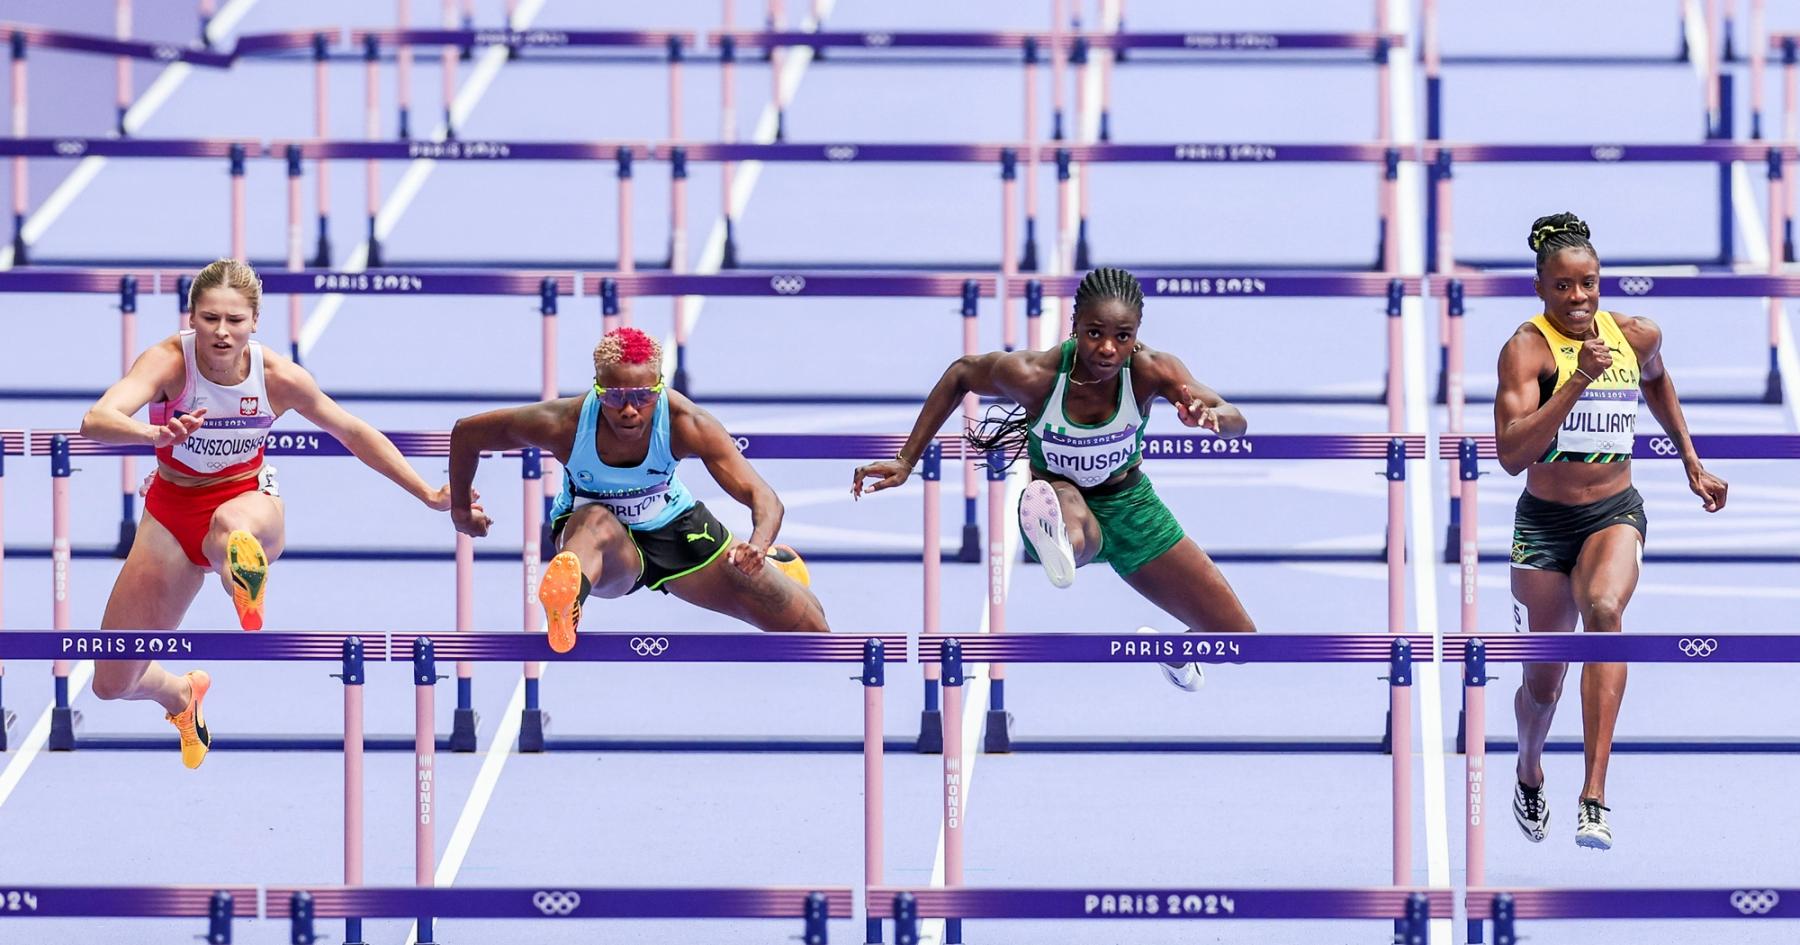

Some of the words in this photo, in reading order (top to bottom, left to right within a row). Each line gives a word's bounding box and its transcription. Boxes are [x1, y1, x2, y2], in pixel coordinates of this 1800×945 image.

[372, 275, 422, 290] 2024
[1215, 278, 1266, 293] 2024
[267, 435, 319, 449] 2024
[1200, 439, 1252, 454] 2024
[1045, 443, 1134, 471] AMUSAN
[134, 638, 192, 653] 2024
[1182, 640, 1240, 656] 2024
[418, 770, 432, 825] MONDO
[946, 773, 960, 828] MONDO
[1469, 771, 1482, 826] MONDO
[1167, 894, 1236, 914] 2024
